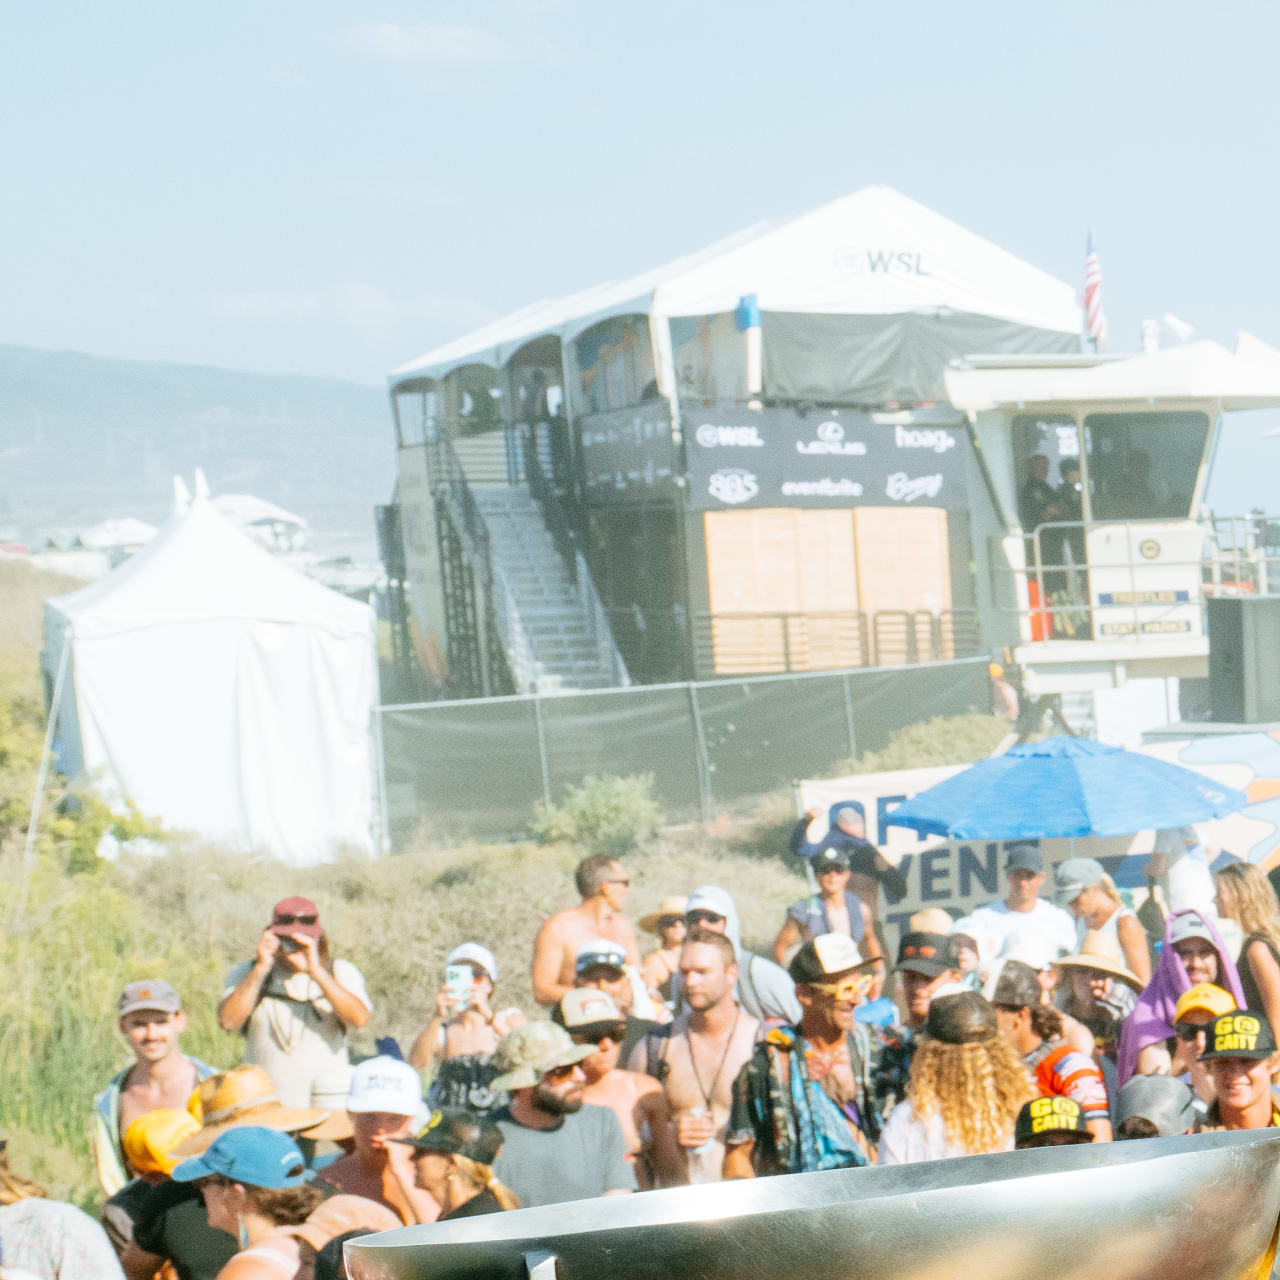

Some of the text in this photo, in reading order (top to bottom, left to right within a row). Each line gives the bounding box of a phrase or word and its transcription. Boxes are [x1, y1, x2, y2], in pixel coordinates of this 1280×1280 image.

[867, 251, 930, 276] WSL
[718, 426, 764, 446] WSL
[797, 441, 866, 455] LEXUS
[1214, 1015, 1260, 1036] GO
[1214, 1033, 1258, 1052] CAITY
